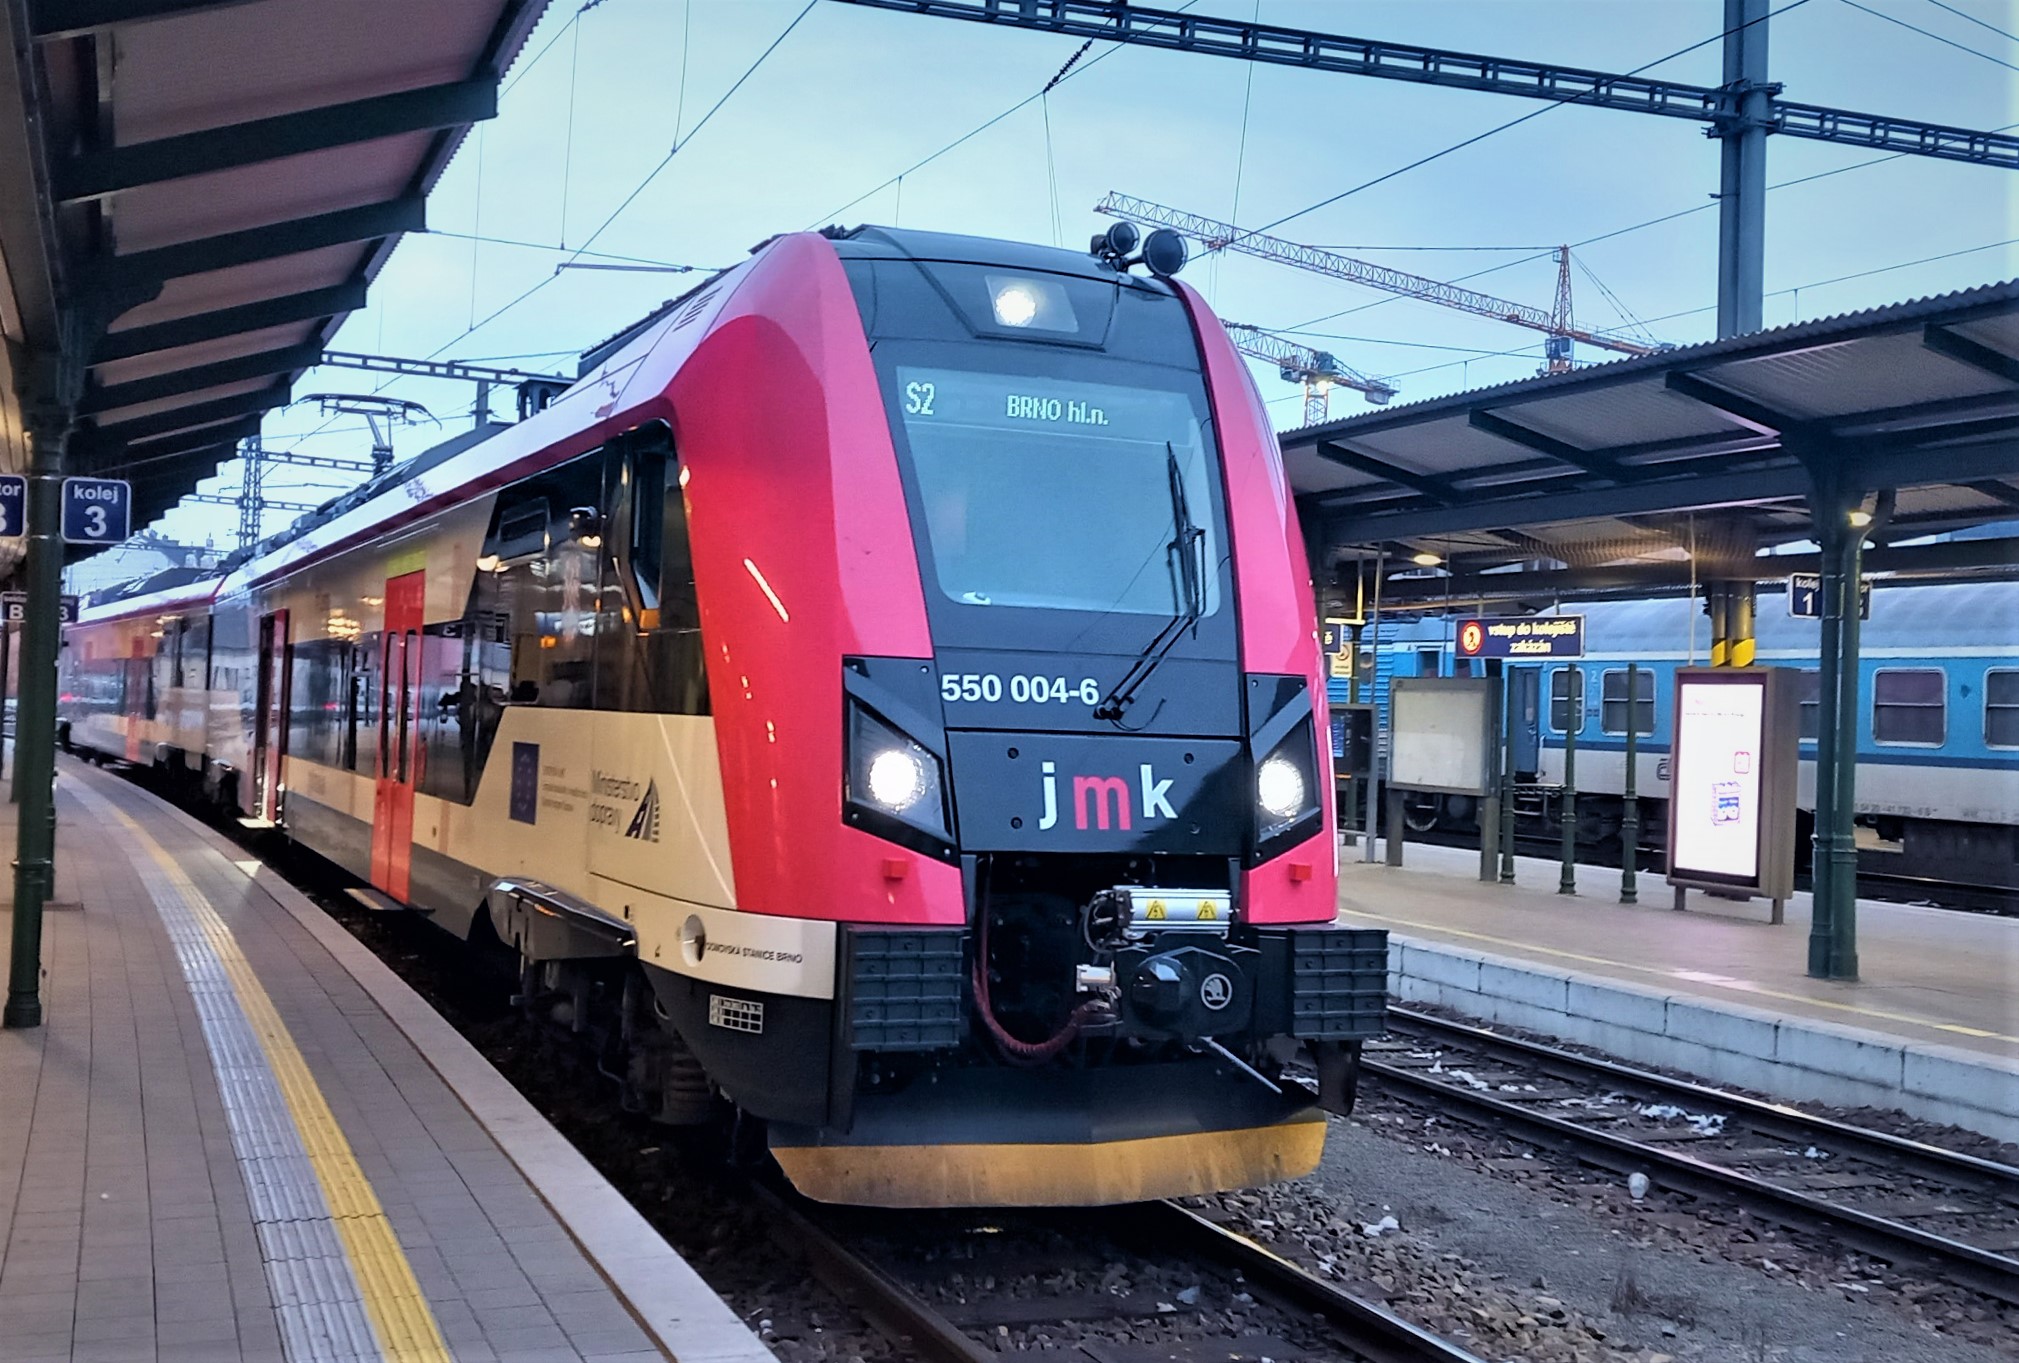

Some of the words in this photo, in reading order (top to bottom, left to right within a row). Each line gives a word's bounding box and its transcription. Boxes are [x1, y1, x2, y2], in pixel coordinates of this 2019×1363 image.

[905, 381, 935, 415] S2
[1007, 395, 1062, 421] BRNO
[1066, 401, 1110, 425] hl.n.
[73, 485, 119, 504] kolej
[84, 505, 107, 537] 3
[9, 604, 24, 620] B
[1802, 592, 1814, 615] 1
[941, 674, 1002, 702] 550
[1010, 675, 1100, 706] 004-6
[1038, 761, 1179, 831] jmk
